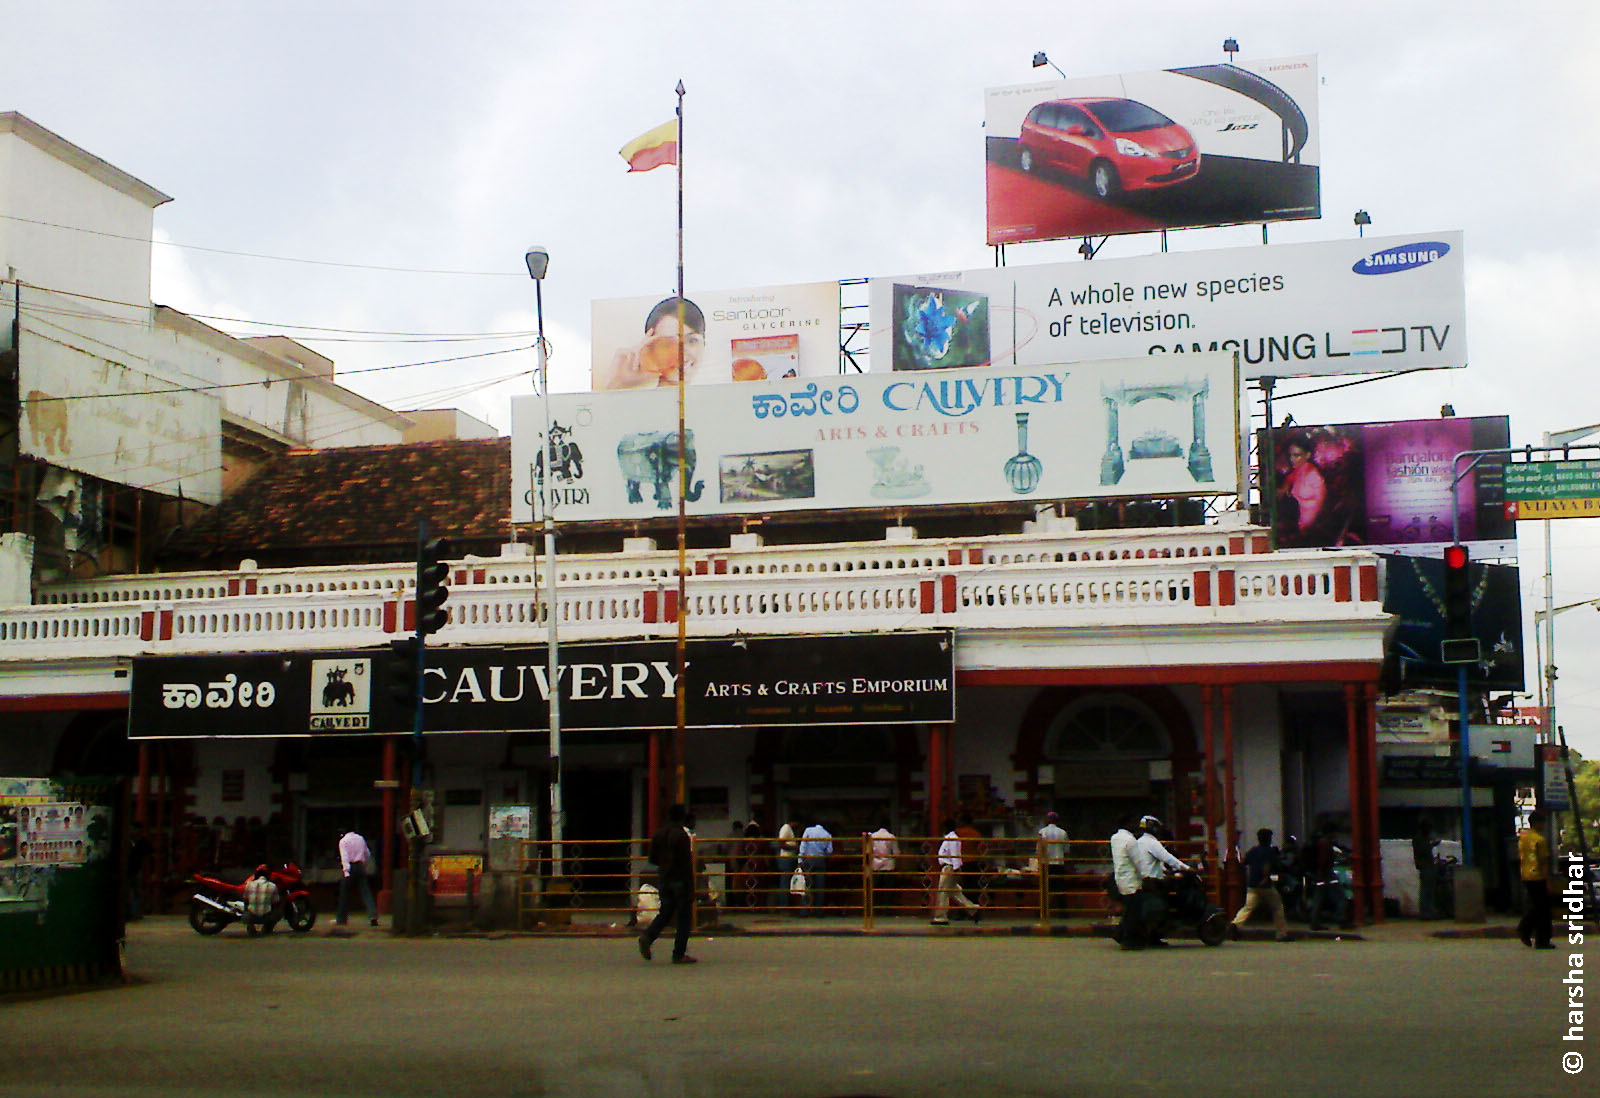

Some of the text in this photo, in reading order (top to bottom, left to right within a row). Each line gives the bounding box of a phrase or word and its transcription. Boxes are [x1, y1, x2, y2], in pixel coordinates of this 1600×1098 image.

[1364, 250, 1439, 267] SAMSUNG
[1048, 272, 1284, 307] A whole new species
[712, 306, 792, 322] Santoor
[742, 318, 822, 331] GLYCERINE
[1049, 309, 1196, 338] of television.
[752, 382, 860, 419] ಕಾವೇರಿ
[814, 420, 980, 442] ARTS & CRAFTS
[162, 673, 276, 709] ಕಾವೇರಿ
[422, 661, 948, 704] CAUVERY ARTS & CRAFTS EMPORIUM
